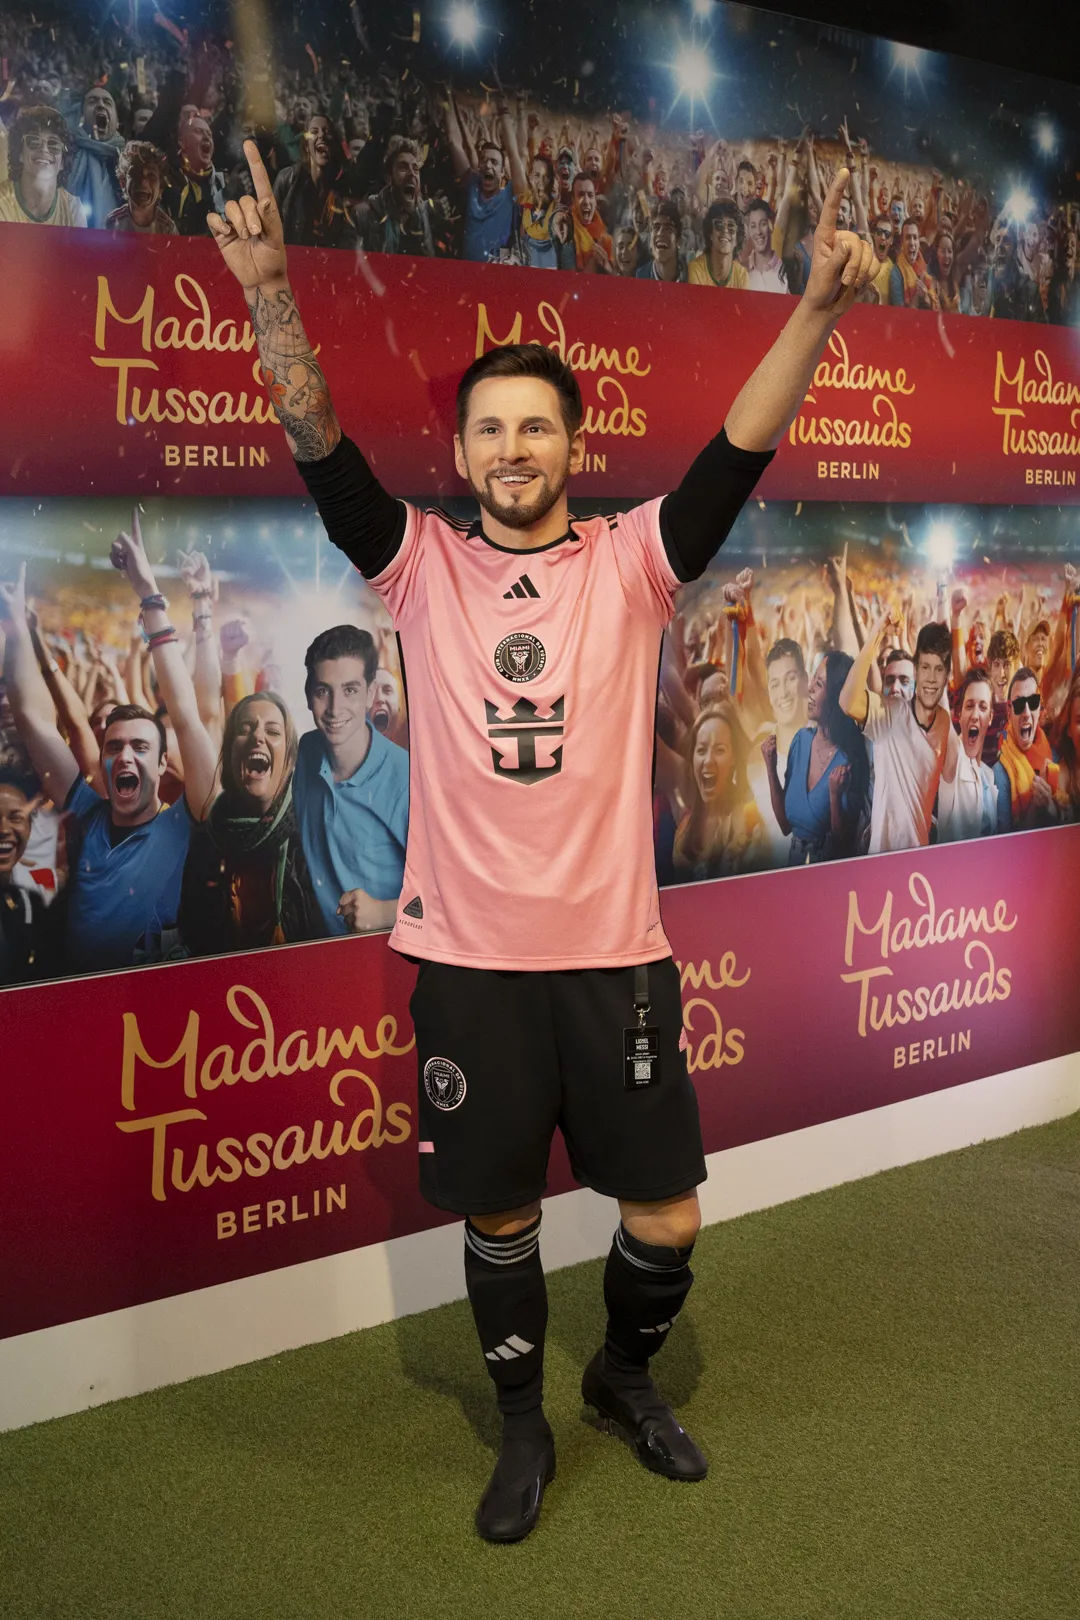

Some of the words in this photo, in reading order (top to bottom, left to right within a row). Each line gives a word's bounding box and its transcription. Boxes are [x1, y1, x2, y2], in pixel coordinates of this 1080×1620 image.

[95, 273, 320, 357] Mada
[475, 301, 651, 377] Mdame
[90, 356, 280, 426] Tussau
[809, 329, 915, 395] adame
[994, 349, 1080, 405] Madam
[164, 445, 265, 467] BERLIN
[991, 406, 1080, 455] Tussau
[817, 461, 880, 480] BERLIN
[1025, 469, 1076, 486] BERLIN
[496, 634, 536, 657] INTERNACIONAL
[844, 872, 1018, 967] Madame
[840, 940, 1012, 1037] Tussauds
[121, 984, 416, 1112] Madame
[893, 1029, 972, 1069] BERLIN
[115, 1069, 412, 1201] Tussauds
[216, 1183, 347, 1240] BERLIN
